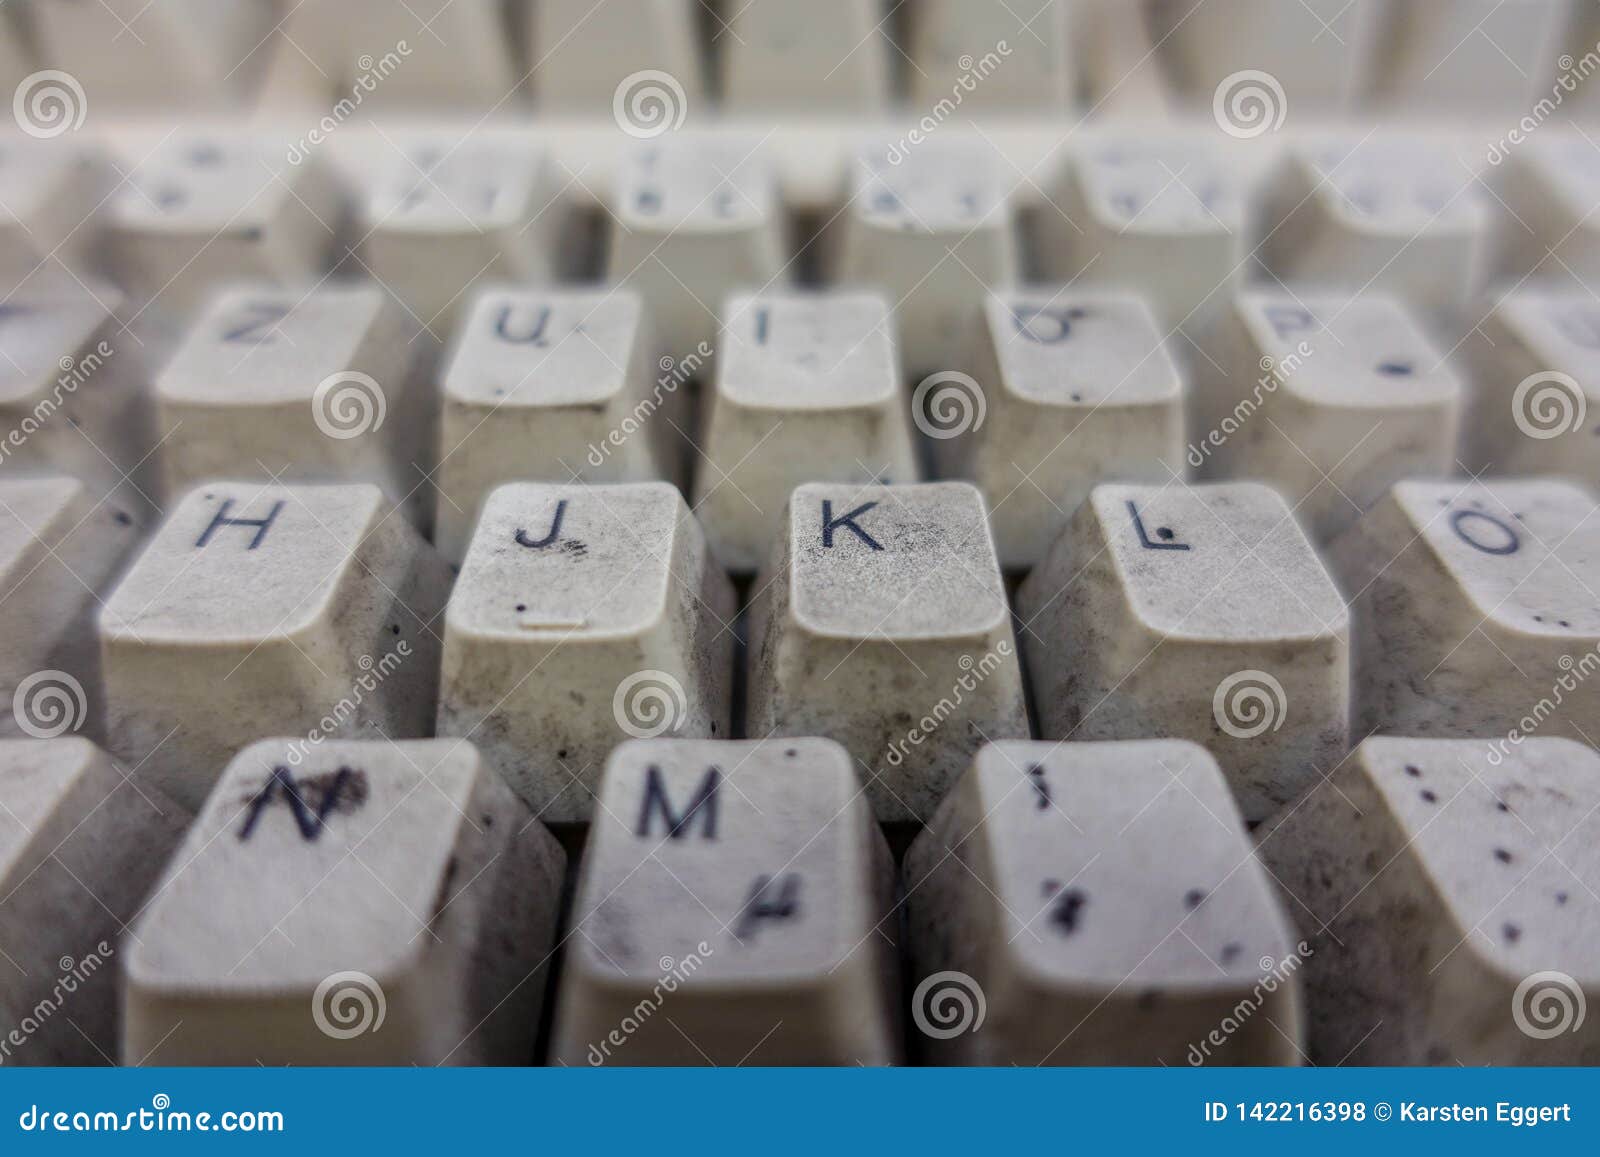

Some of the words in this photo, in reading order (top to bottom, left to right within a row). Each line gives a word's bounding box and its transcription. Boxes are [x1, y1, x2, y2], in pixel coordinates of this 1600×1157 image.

[494, 305, 552, 347] U
[195, 498, 287, 551] H
[514, 499, 568, 549] J
[821, 499, 885, 551] K
[1126, 500, 1191, 550] L
[236, 764, 354, 842] N
[634, 762, 723, 840] M
